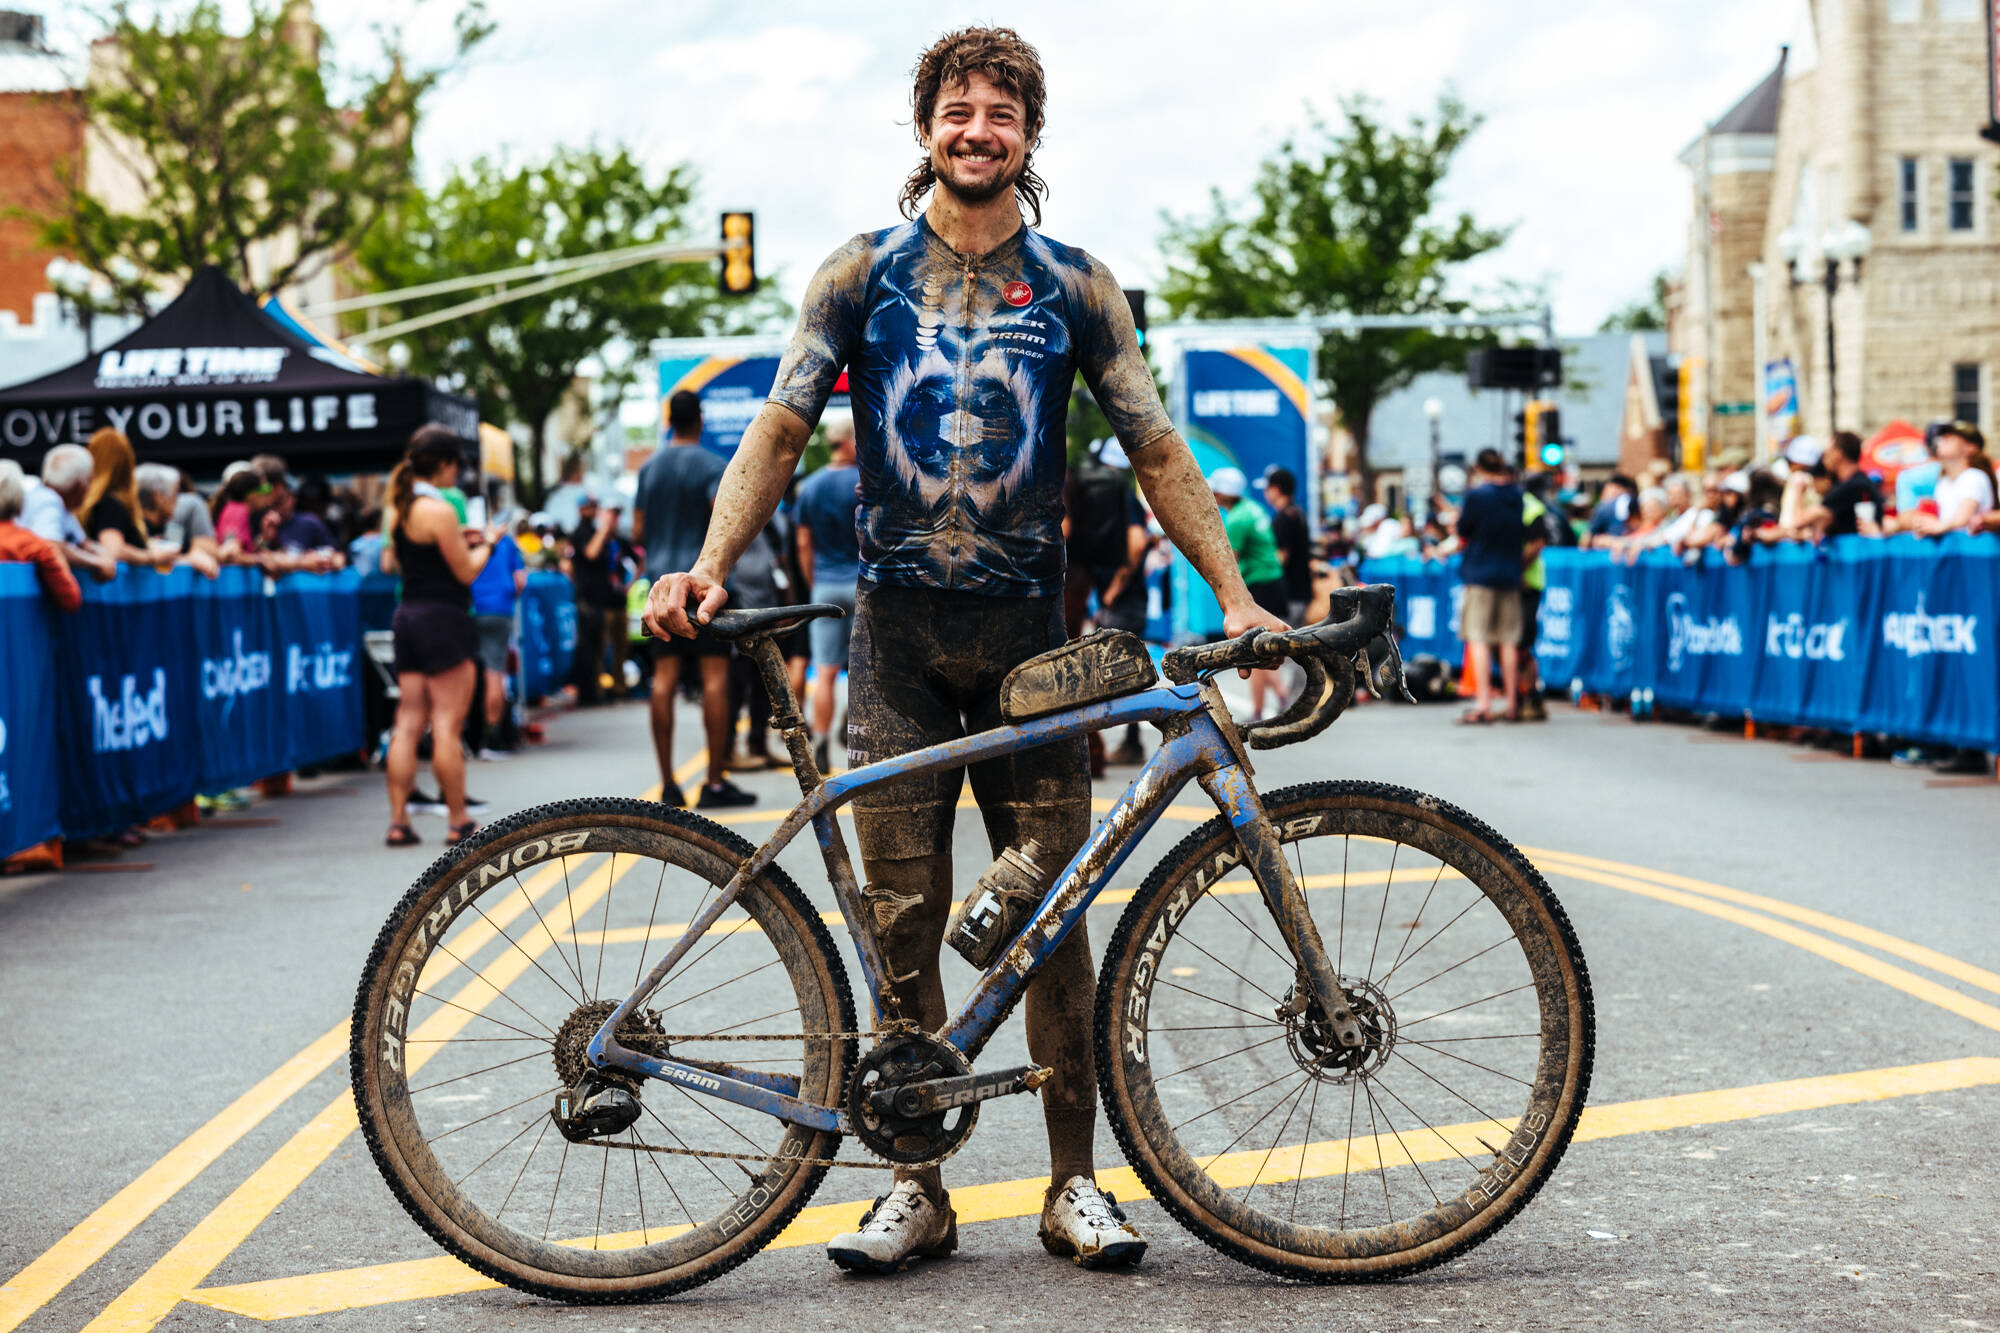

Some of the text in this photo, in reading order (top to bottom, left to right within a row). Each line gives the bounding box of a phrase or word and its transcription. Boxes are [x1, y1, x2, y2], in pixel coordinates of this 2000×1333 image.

[98, 347, 288, 377] LIFE TIME
[0, 394, 378, 447] OVE YOUR LIFE
[383, 831, 591, 1072] BONTRAGER
[659, 1064, 721, 1091] SRAM
[1465, 1111, 1547, 1211] AEOLUS
